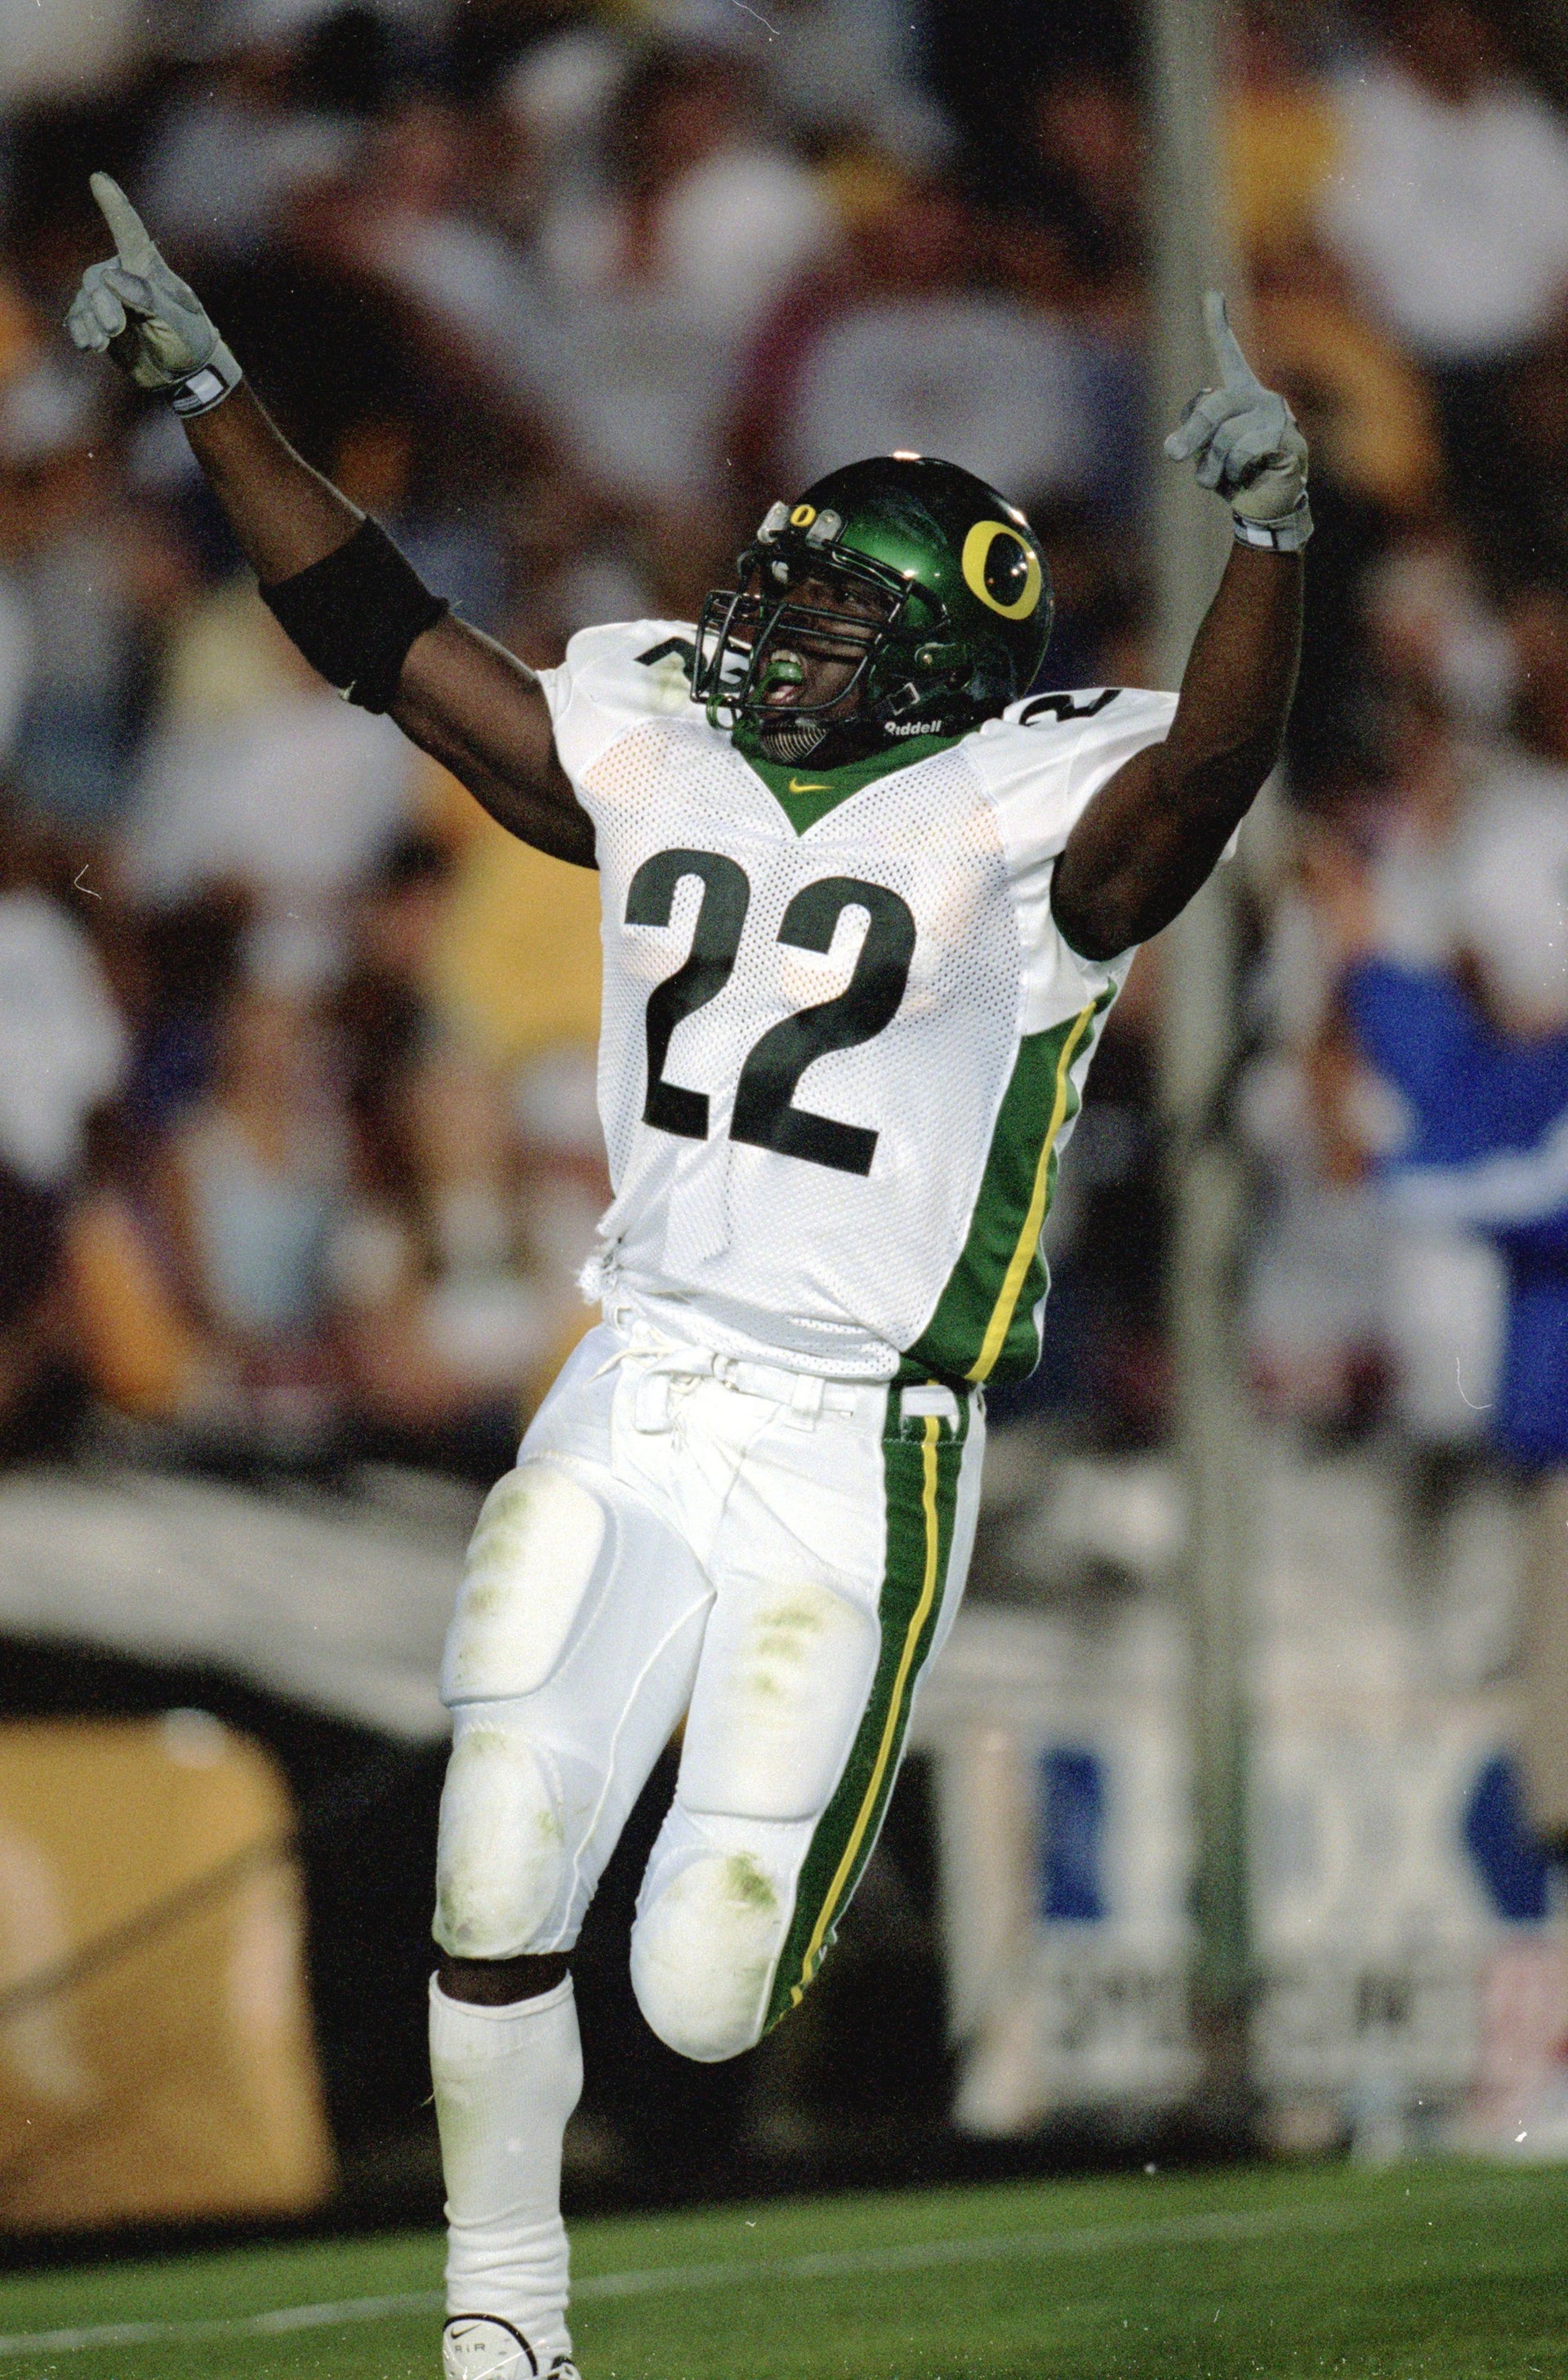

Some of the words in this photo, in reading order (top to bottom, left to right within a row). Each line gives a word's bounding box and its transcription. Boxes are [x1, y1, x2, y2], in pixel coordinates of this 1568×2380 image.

[962, 521, 1043, 620] O
[884, 719, 942, 736] Riddell
[624, 847, 916, 1177] 22
